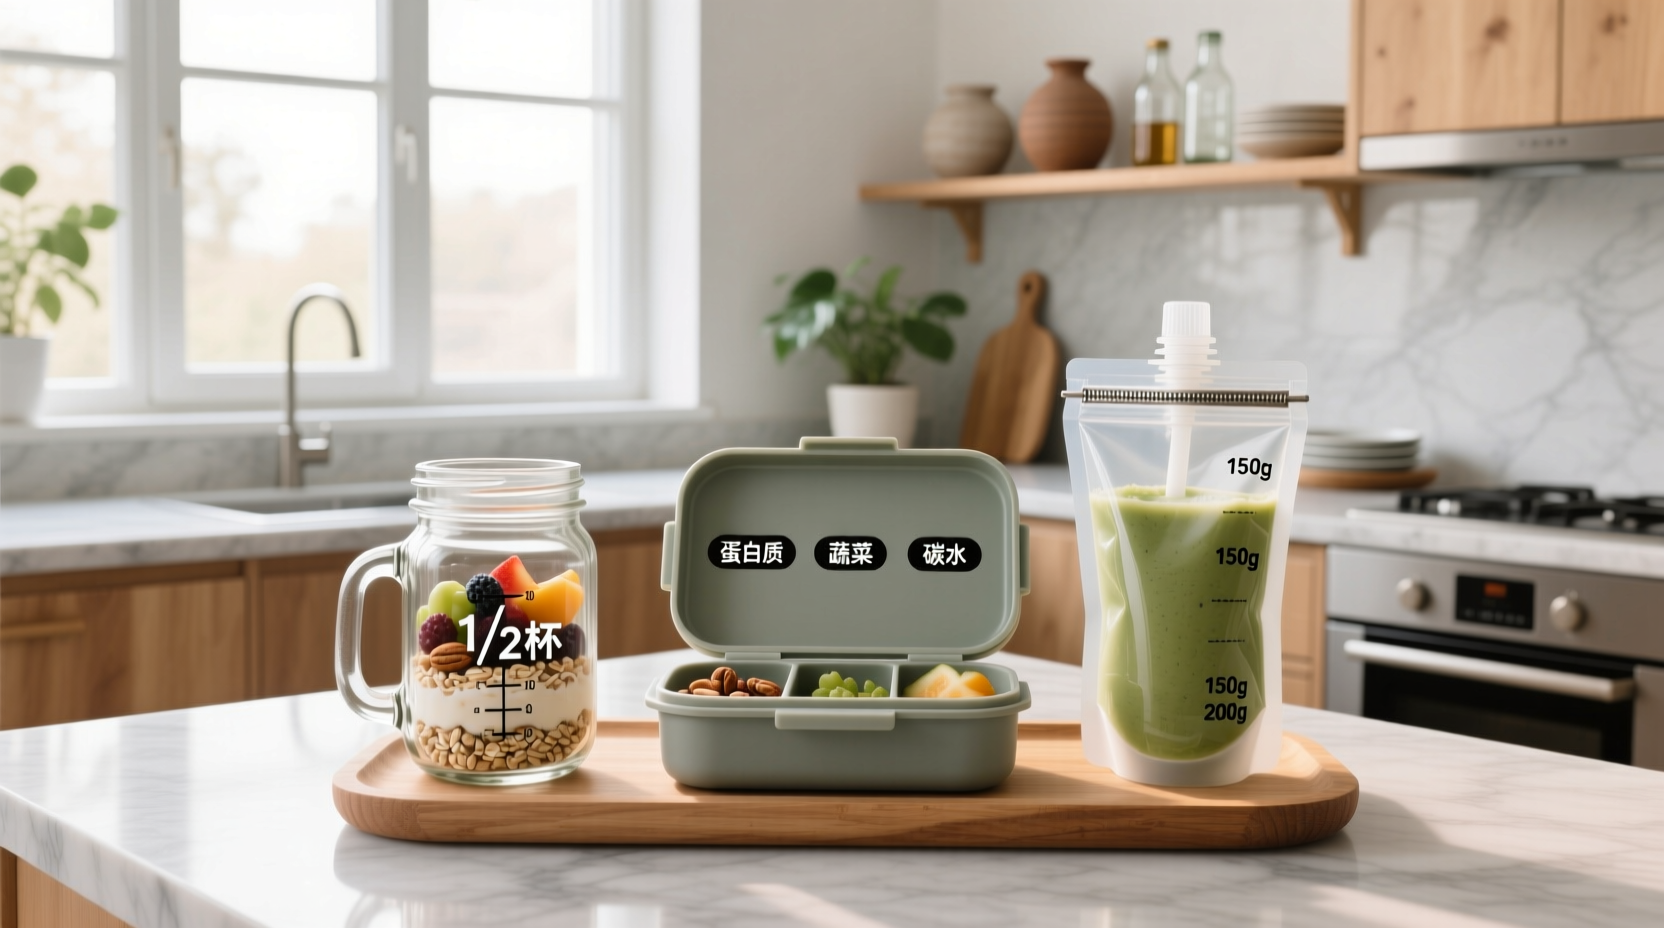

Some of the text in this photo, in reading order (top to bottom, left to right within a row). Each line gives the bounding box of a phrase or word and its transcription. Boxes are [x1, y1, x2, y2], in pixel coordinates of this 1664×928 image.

[1227, 457, 1272, 481] 150g
[720, 540, 784, 564] 蛋白质
[828, 541, 874, 565] 蔬菜
[922, 542, 967, 566] 碳水
[1216, 547, 1260, 571] 150g
[458, 604, 562, 666] 1/2杯
[1205, 676, 1248, 699] 150g
[1204, 702, 1248, 724] 200g
